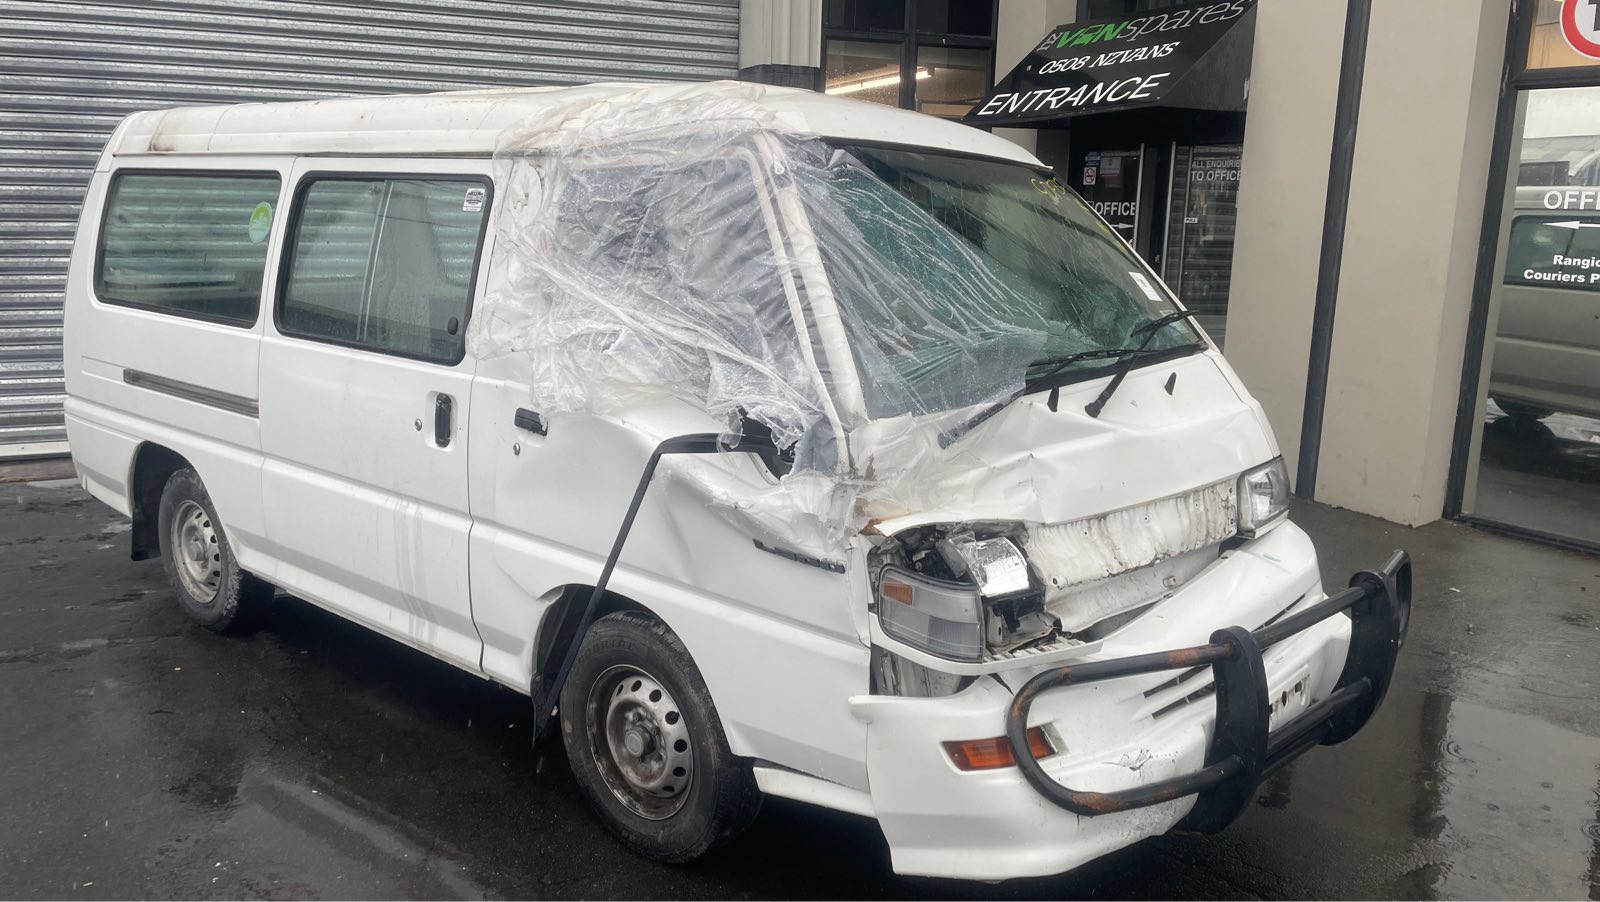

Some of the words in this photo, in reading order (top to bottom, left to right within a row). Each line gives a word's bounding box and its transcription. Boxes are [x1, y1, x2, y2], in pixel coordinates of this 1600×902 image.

[1039, 56, 1091, 74] 0508
[1088, 41, 1181, 68] NZVANS
[977, 72, 1171, 116] ENTRANCE
[1191, 160, 1204, 168] ALL
[1191, 170, 1204, 181] TO
[1206, 170, 1241, 181] OFFICE
[1095, 202, 1136, 216] OFFICE
[1523, 269, 1586, 283] Couriers
